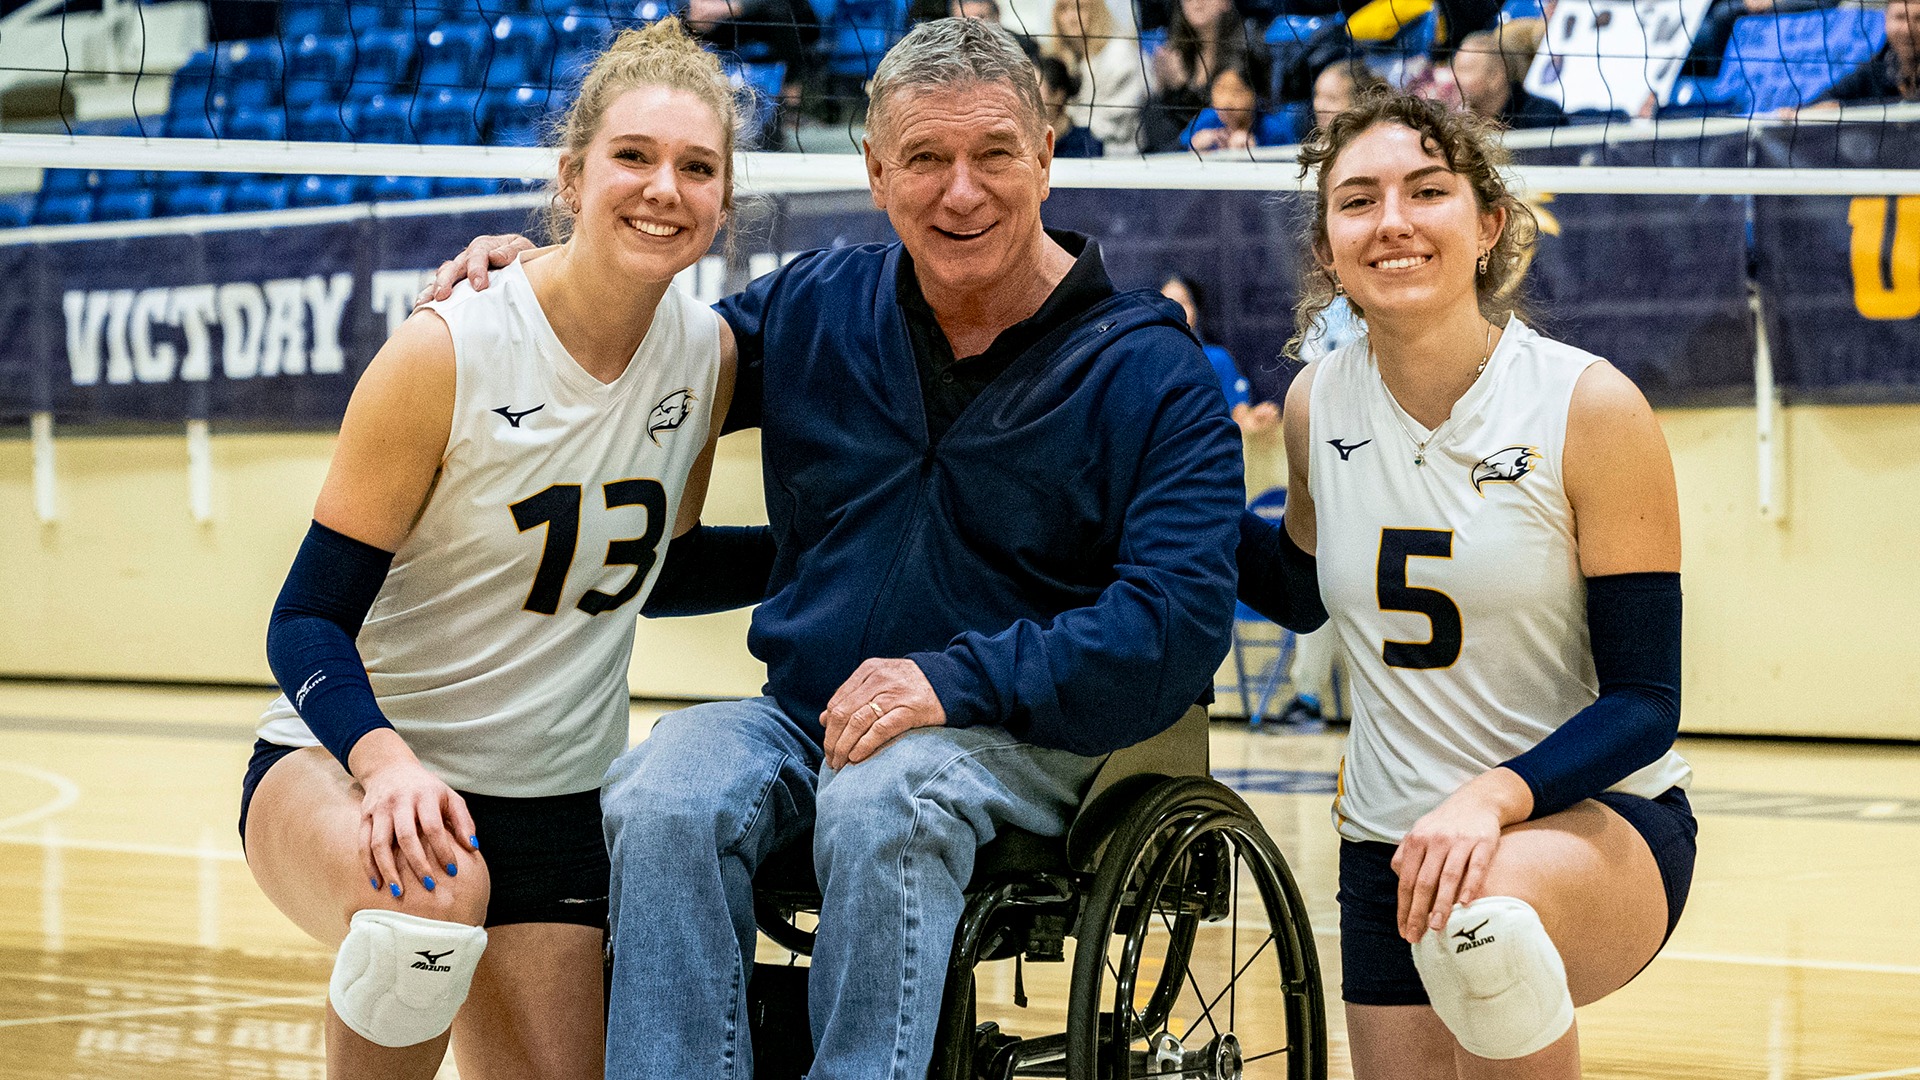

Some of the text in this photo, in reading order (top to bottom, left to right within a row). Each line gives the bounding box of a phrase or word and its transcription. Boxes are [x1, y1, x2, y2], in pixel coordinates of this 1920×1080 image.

[63, 273, 354, 385] VICTORY
[508, 478, 667, 616] 13
[1376, 526, 1464, 671] 5
